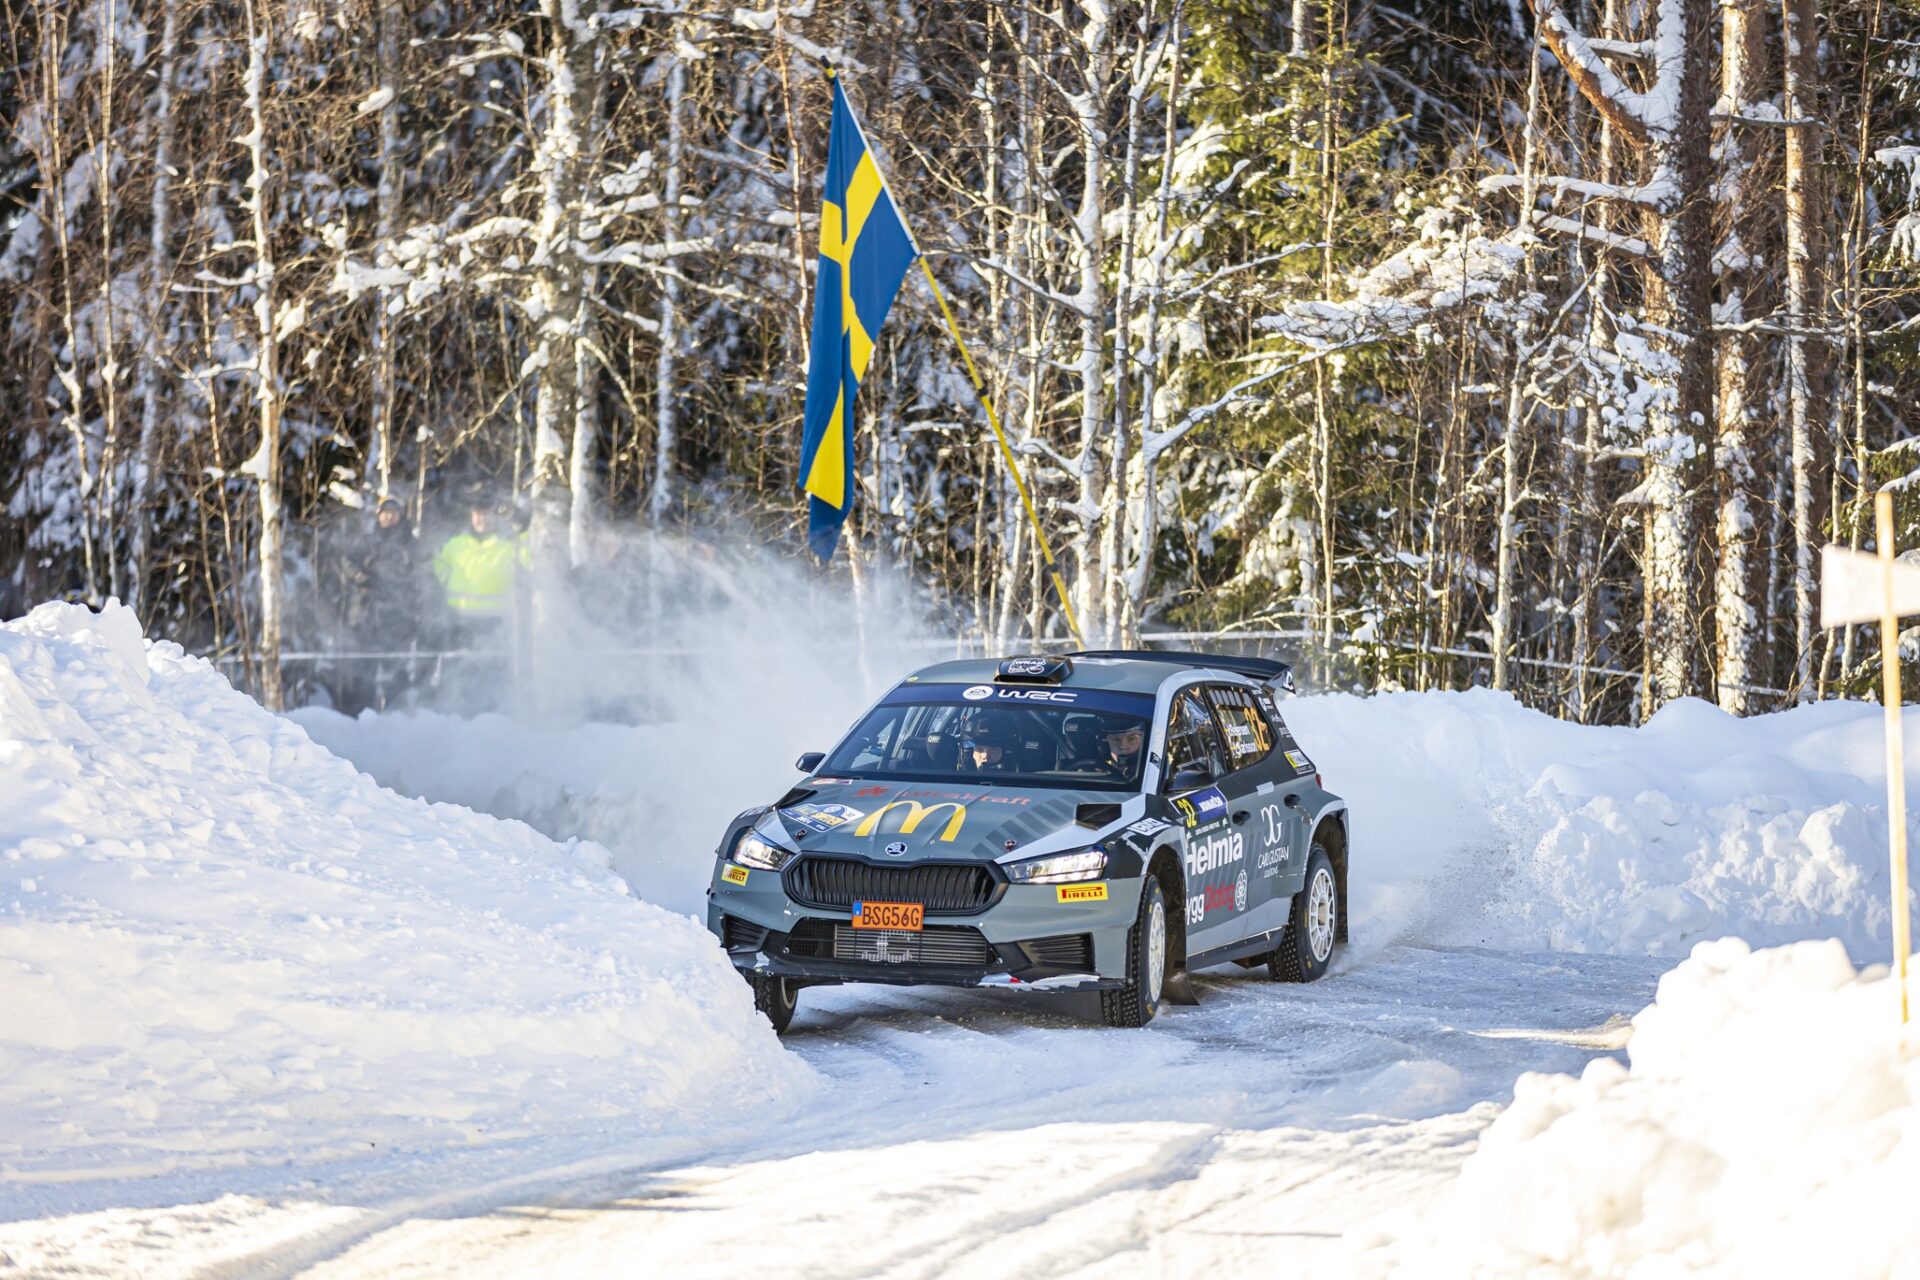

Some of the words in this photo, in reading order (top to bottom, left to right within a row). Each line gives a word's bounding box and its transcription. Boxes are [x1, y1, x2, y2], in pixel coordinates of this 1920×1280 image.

[998, 689, 1078, 703] WRC
[1177, 799, 1197, 828] 32
[1186, 828, 1243, 876] Helmia
[1062, 886, 1103, 899] PIRELLI
[862, 905, 920, 927] BSG56G
